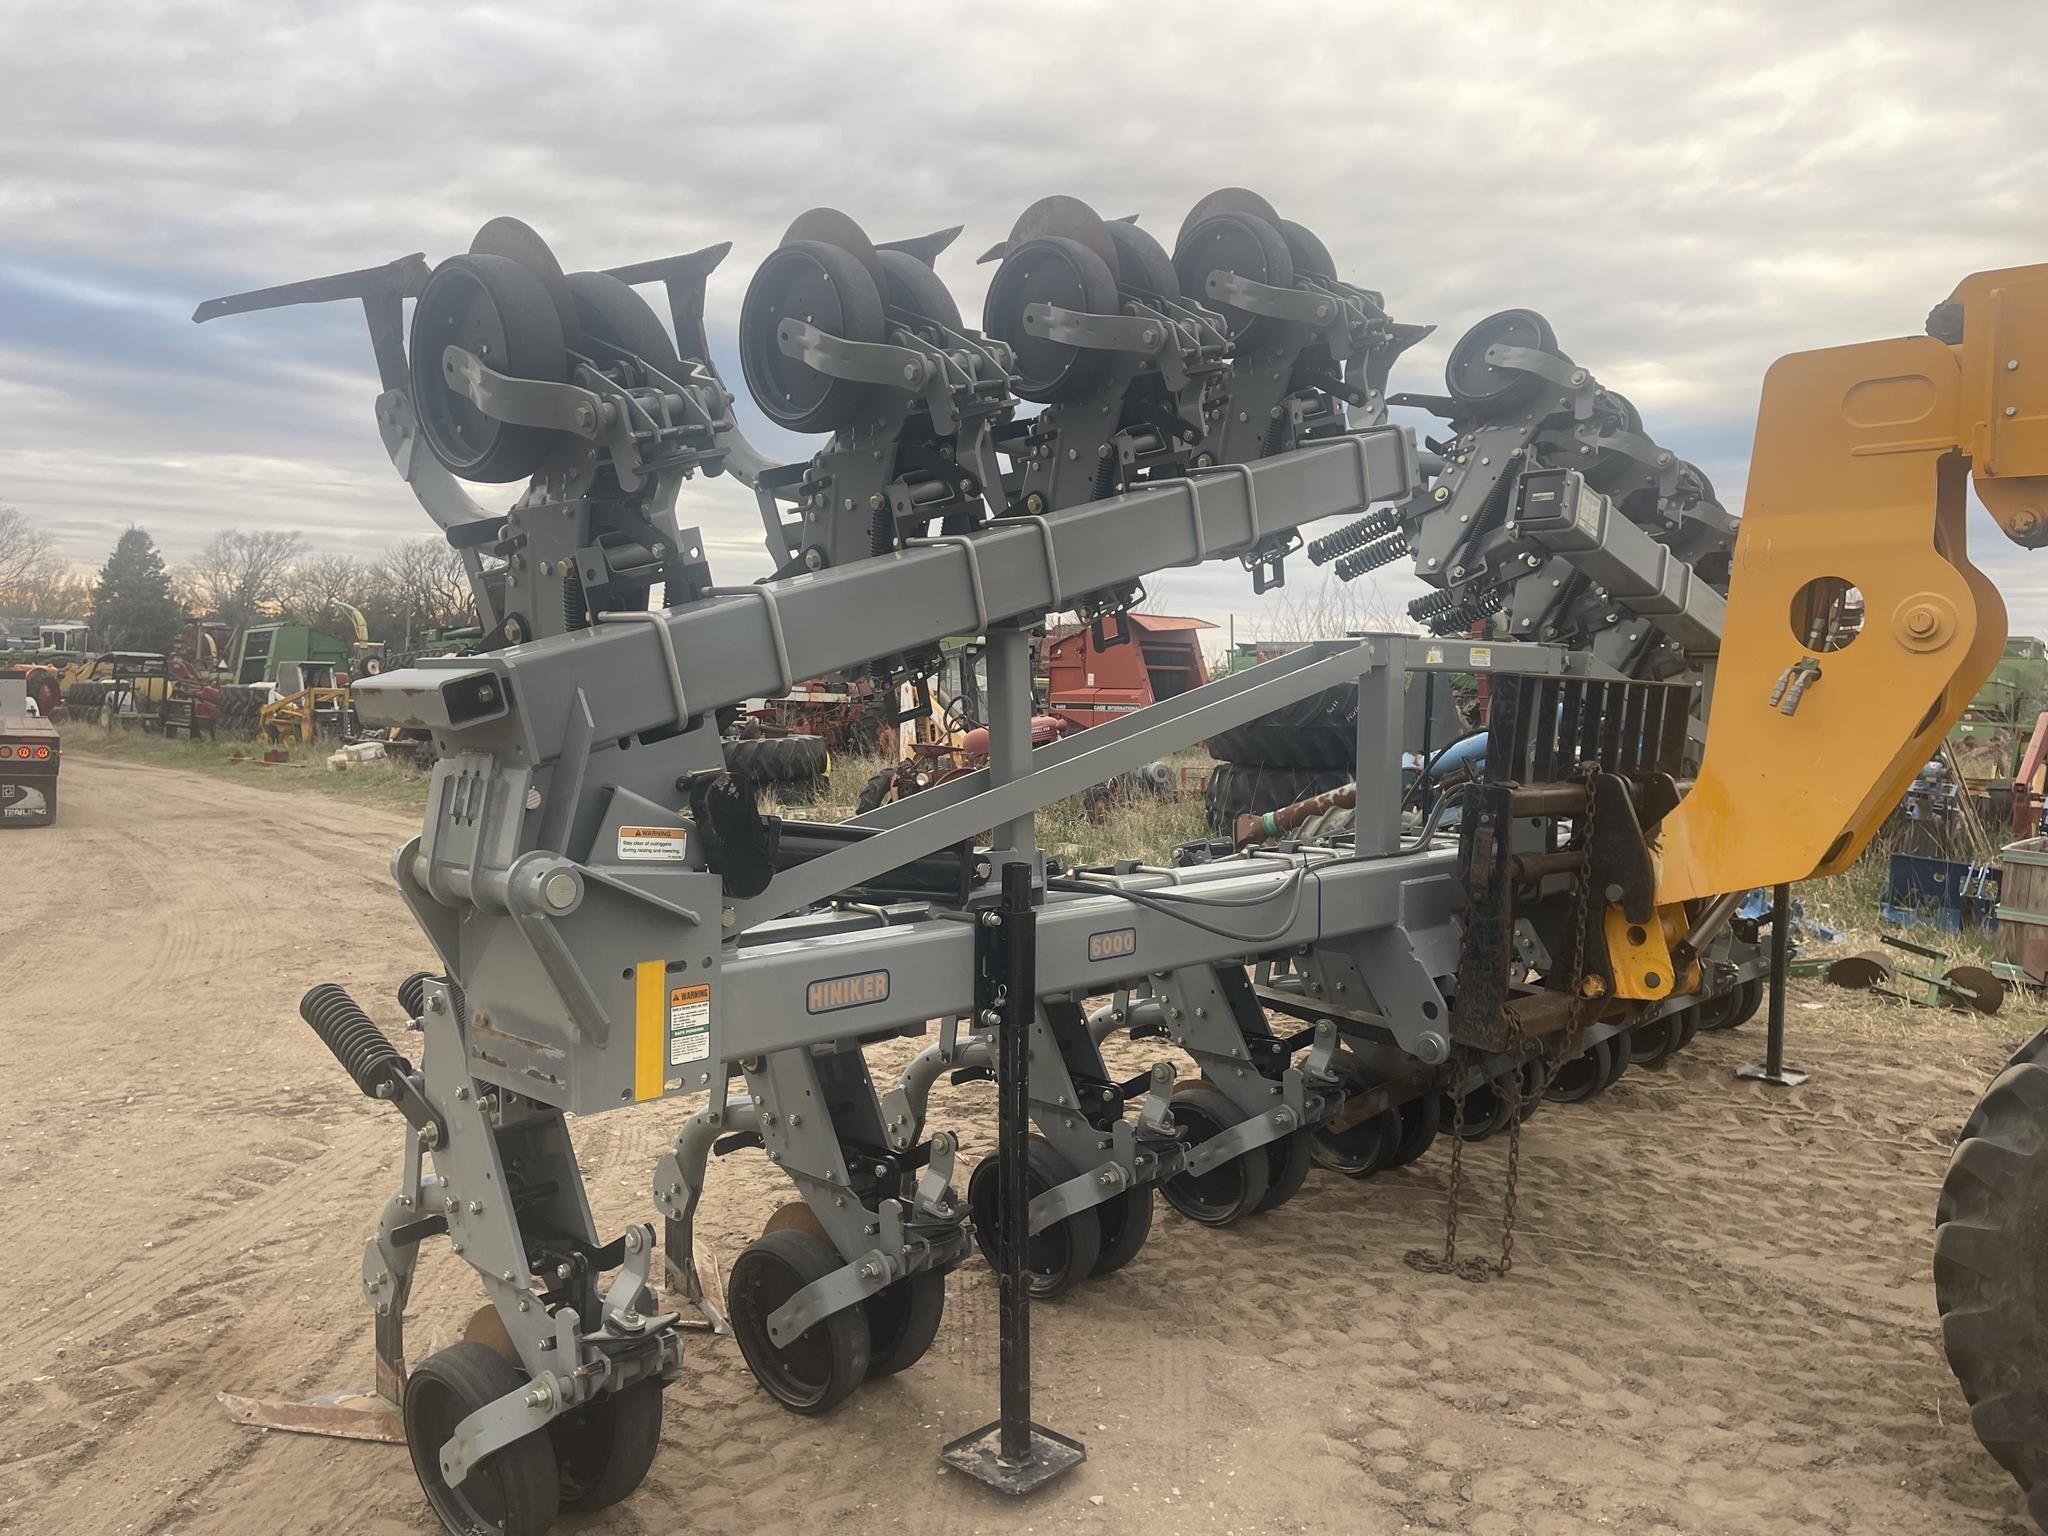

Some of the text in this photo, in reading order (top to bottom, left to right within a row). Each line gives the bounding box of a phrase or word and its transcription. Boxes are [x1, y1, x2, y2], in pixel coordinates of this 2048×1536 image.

[1091, 932, 1133, 957] 6000
[681, 989, 708, 1000] WARNING
[811, 975, 886, 1009] HINIKER
